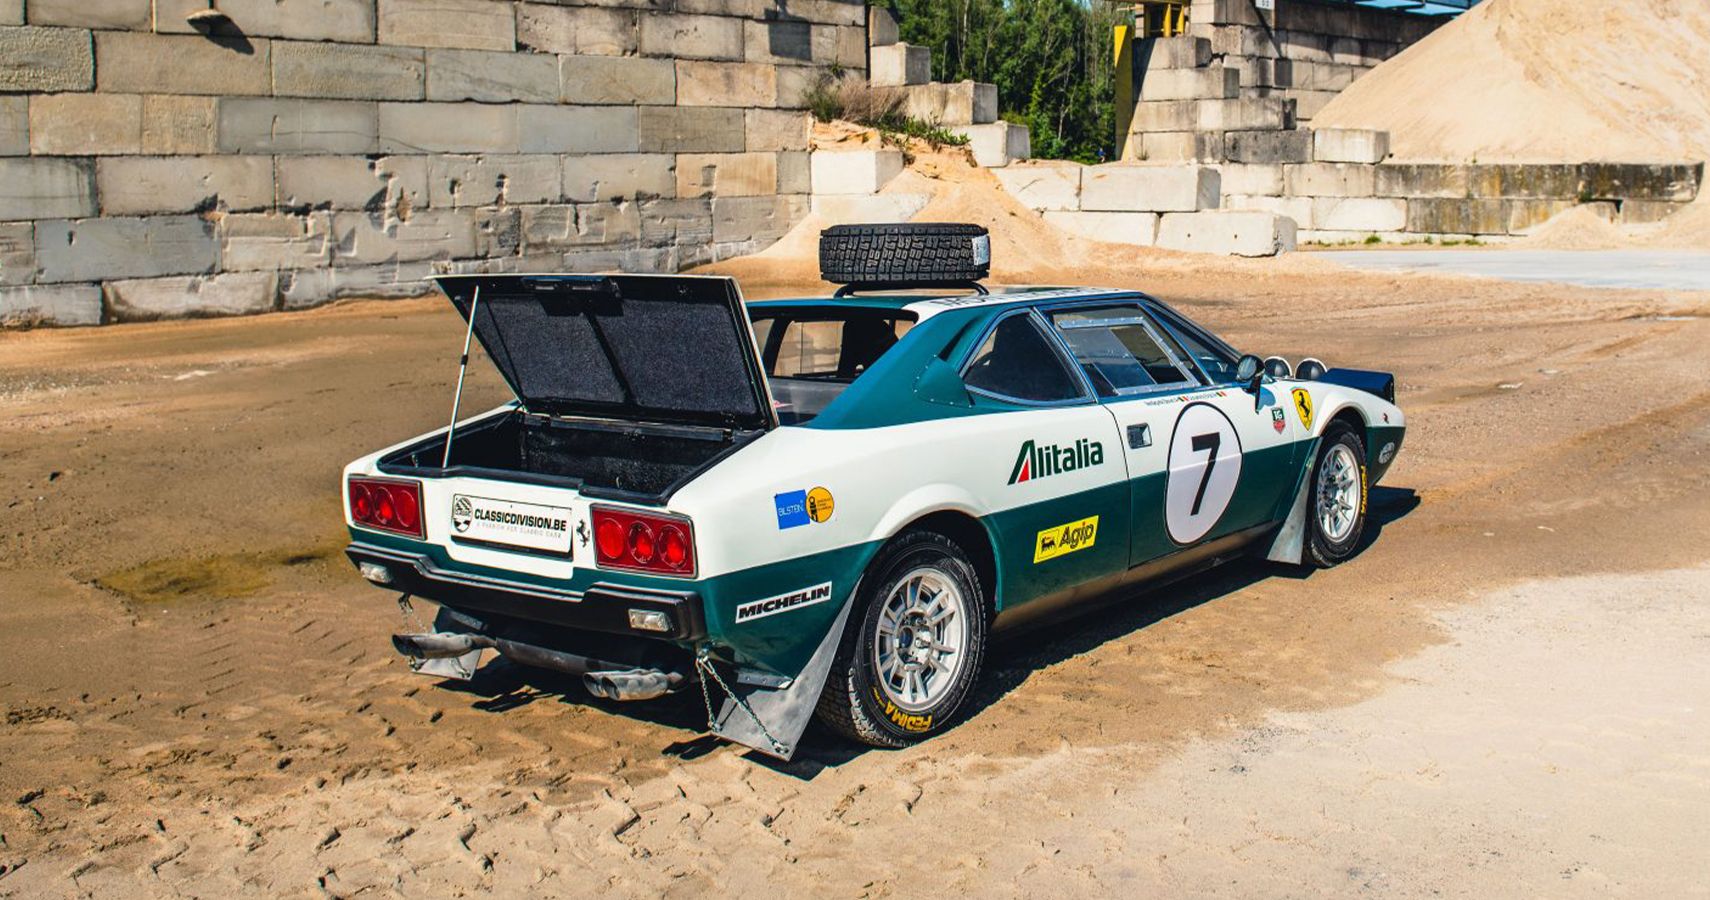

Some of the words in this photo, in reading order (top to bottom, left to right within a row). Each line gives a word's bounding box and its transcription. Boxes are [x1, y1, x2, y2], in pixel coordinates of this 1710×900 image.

[1007, 438, 1104, 486] Alitalia
[1191, 432, 1220, 516] 7
[474, 508, 567, 532] CLASSICDIVISION.BE
[1059, 521, 1094, 549] Agip
[738, 585, 830, 619] MICHELIN
[885, 700, 932, 732] FEDIMA
